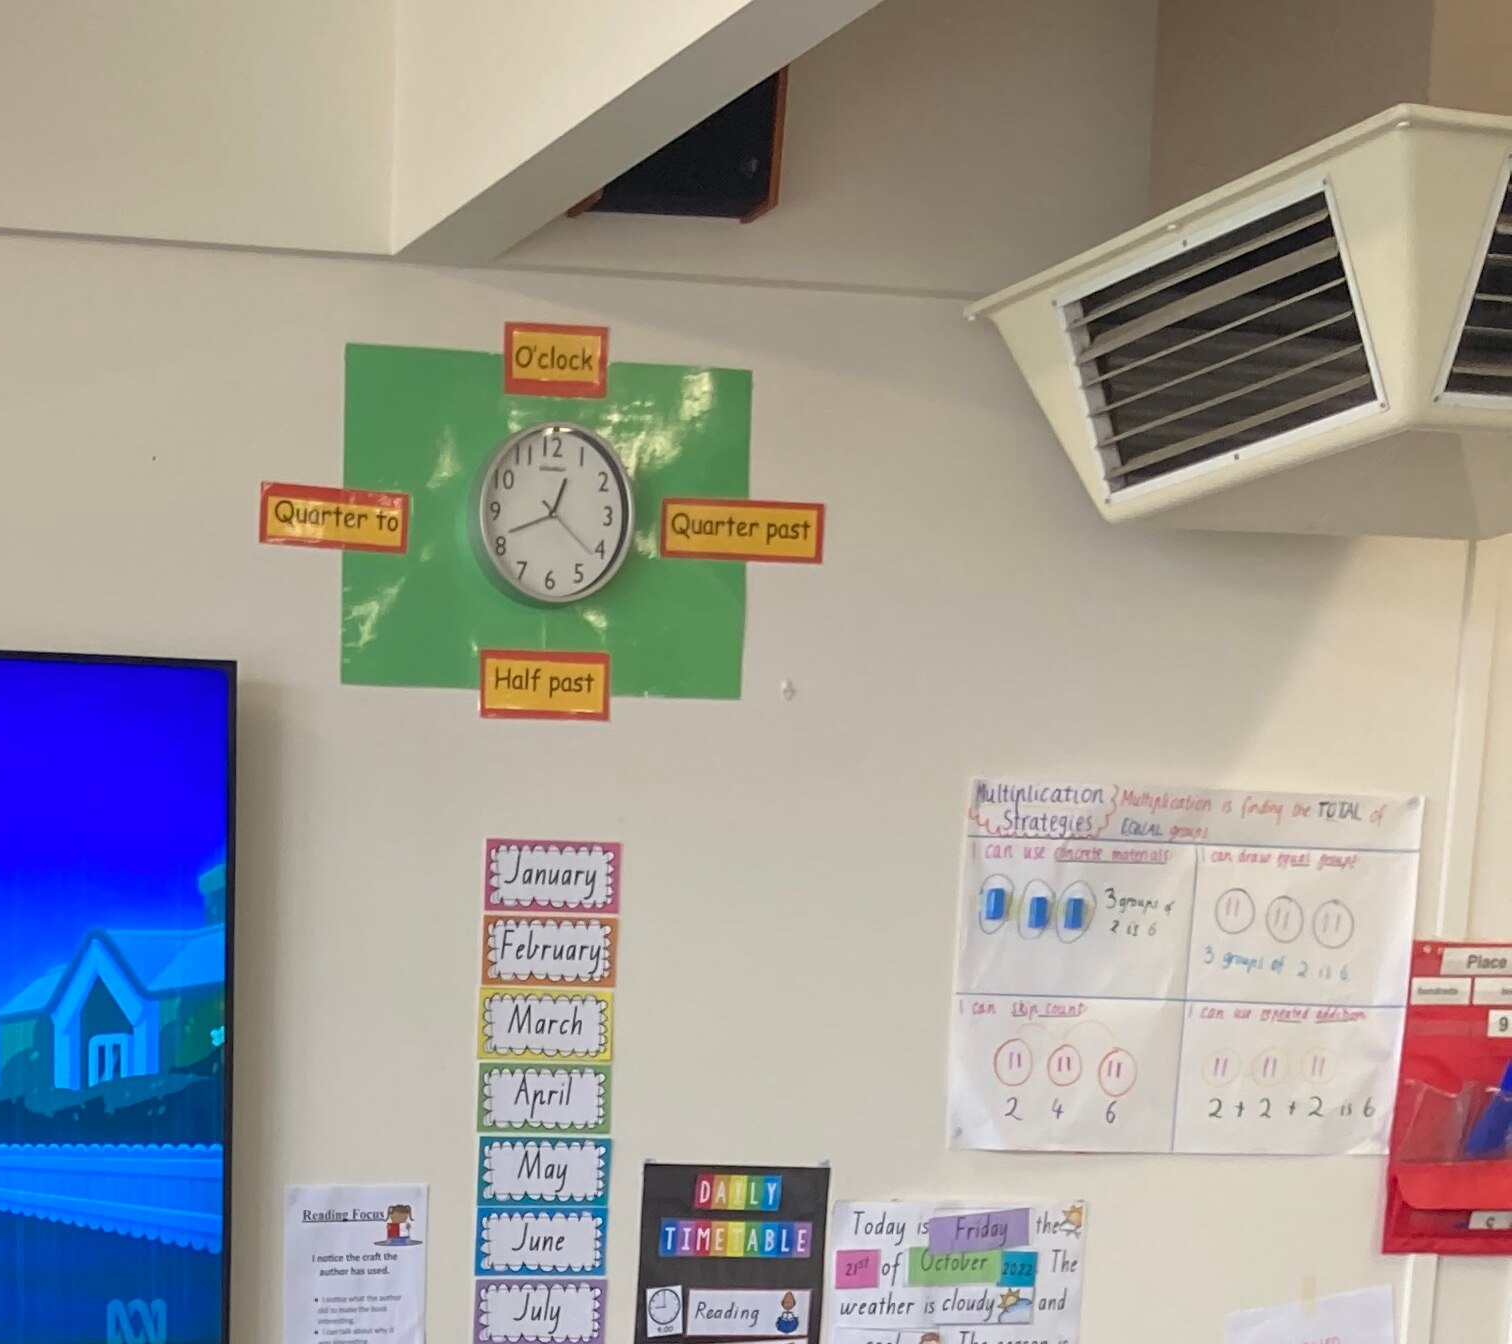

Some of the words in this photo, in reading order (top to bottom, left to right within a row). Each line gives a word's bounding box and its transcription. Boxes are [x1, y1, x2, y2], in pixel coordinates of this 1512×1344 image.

[515, 345, 592, 370] O'clock
[516, 444, 532, 464] 11
[543, 436, 563, 457] 12
[580, 446, 584, 467] 1
[494, 469, 514, 489] 10
[599, 472, 608, 492] 2
[274, 499, 369, 530] Quarter
[376, 507, 399, 534] to
[490, 502, 500, 520] 9
[604, 506, 612, 526] 3
[671, 511, 758, 538] Quarter
[766, 520, 811, 544] past
[496, 536, 506, 556] 8
[595, 540, 604, 559] 4
[517, 561, 527, 580] 7
[545, 571, 555, 589] 6
[573, 563, 584, 583] 5
[494, 667, 541, 691] Half
[548, 672, 595, 698] past
[976, 784, 1104, 813] Multiplication
[1319, 801, 1362, 821] TOTAL
[1004, 809, 1092, 837] Strategies
[1121, 817, 1164, 835] EQUAL
[985, 845, 1013, 859] can
[1024, 845, 1045, 859] use
[1211, 851, 1232, 862] can
[504, 853, 597, 900] January
[1105, 887, 1116, 909] 3
[1119, 897, 1159, 914] groups
[1110, 920, 1118, 934] 2
[1127, 921, 1139, 936] is
[1148, 922, 1157, 936] 6
[500, 929, 602, 975] February
[1204, 945, 1214, 964] 3
[1297, 961, 1308, 978] 2
[1340, 965, 1349, 980] 6
[1467, 954, 1507, 969] Place
[972, 1001, 997, 1015] can
[1012, 1000, 1038, 1018] skip
[1045, 1002, 1087, 1016] count
[1200, 1007, 1224, 1019] can
[508, 1006, 583, 1036] March
[1499, 1017, 1508, 1032] 9
[514, 1077, 572, 1119] April
[1209, 1098, 1222, 1118] 2
[1234, 1102, 1245, 1117] +
[1259, 1098, 1271, 1118] 2
[1288, 1102, 1296, 1116] +
[1308, 1096, 1323, 1117] 2
[1341, 1102, 1352, 1116] is
[1363, 1097, 1374, 1118] 6
[1005, 1096, 1023, 1121] 2
[1052, 1098, 1064, 1119] 4
[1106, 1100, 1116, 1124] 6
[517, 1150, 568, 1193] May
[699, 1181, 777, 1205] DAILY
[302, 1209, 349, 1222] Reading
[352, 1209, 385, 1221] Focus
[512, 1222, 565, 1253] June
[853, 1211, 906, 1246] Today
[917, 1214, 929, 1235] is
[955, 1218, 1008, 1246] Friday
[1036, 1212, 1060, 1234] the
[665, 1227, 807, 1252] TIMETABLE
[317, 1254, 343, 1262] notice
[346, 1253, 360, 1262] the
[362, 1253, 382, 1261] craft
[384, 1252, 398, 1261] the
[319, 1267, 348, 1276] author
[351, 1267, 365, 1276] has
[882, 1252, 903, 1286] of
[920, 1254, 989, 1272] October
[1052, 1250, 1077, 1273] The
[513, 1288, 561, 1334] July
[695, 1302, 760, 1327] Reading
[840, 1292, 915, 1315] weather
[924, 1294, 935, 1314] is
[942, 1288, 994, 1322] cloudy
[1038, 1288, 1067, 1310] and
